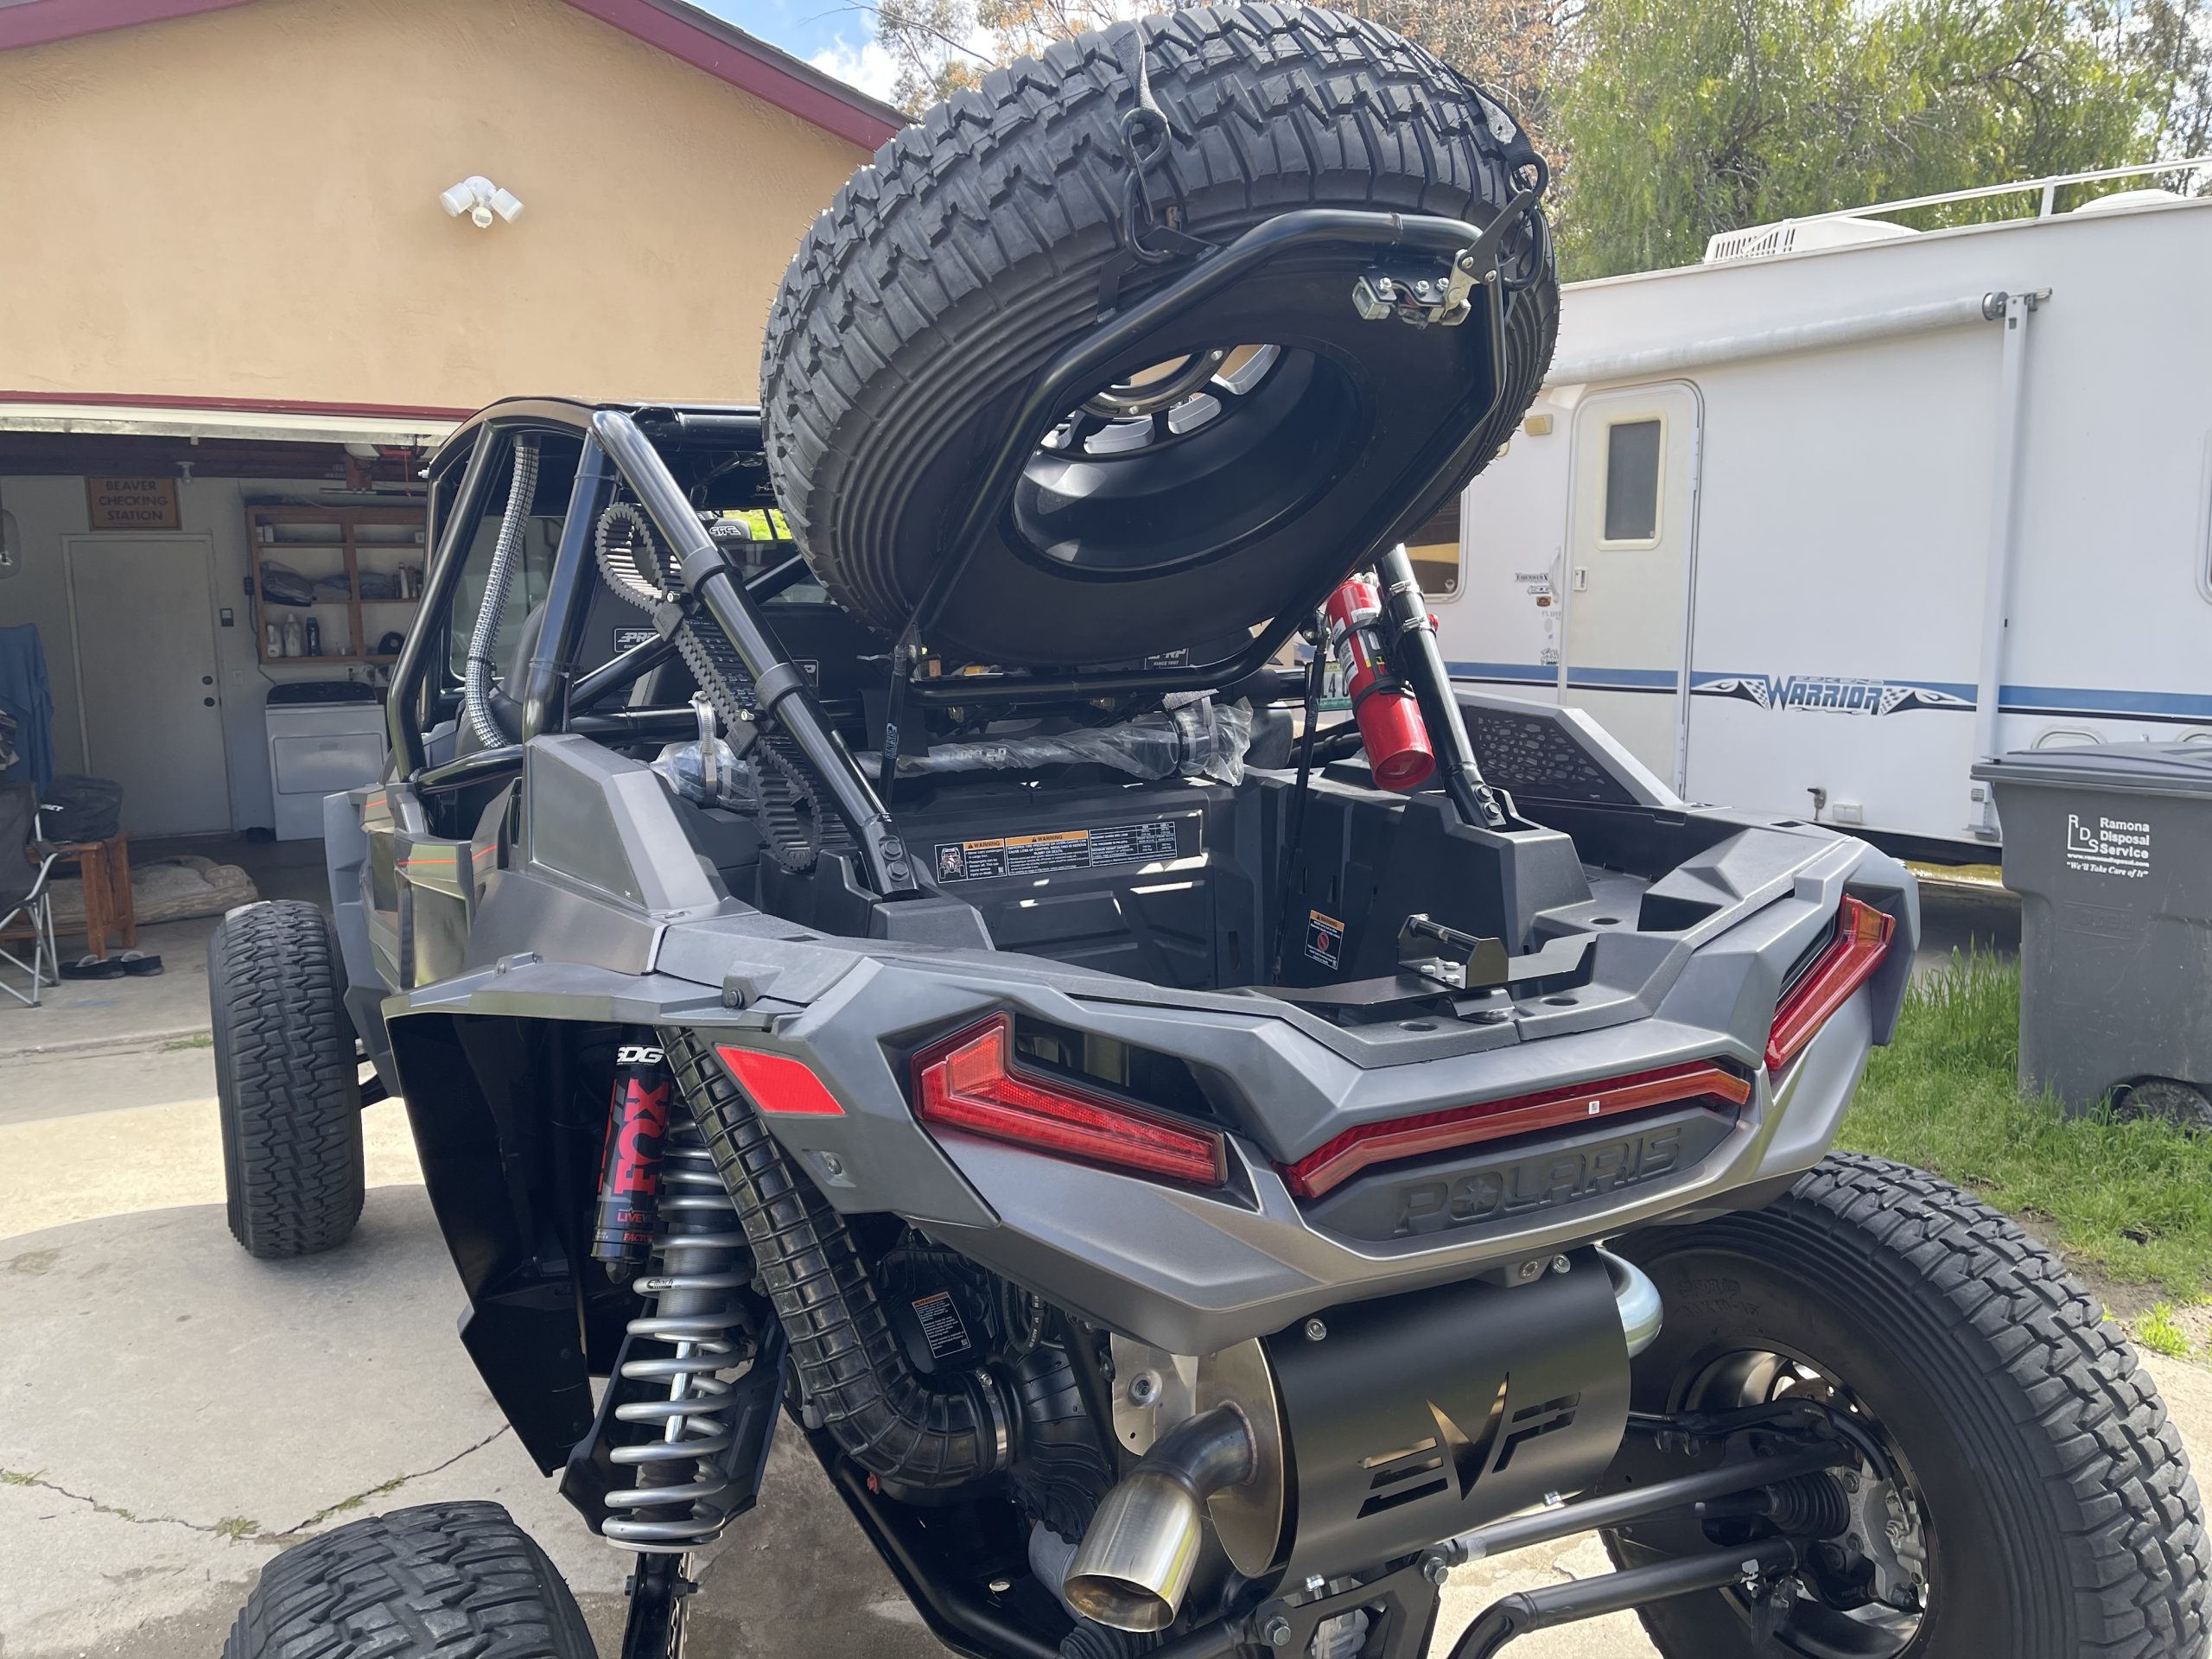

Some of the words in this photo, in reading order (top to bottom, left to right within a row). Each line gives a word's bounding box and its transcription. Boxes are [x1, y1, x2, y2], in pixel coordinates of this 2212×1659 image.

[105, 480, 156, 491] BEAVER
[99, 496, 168, 505] CHECKING
[107, 511, 162, 520] STATION
[1769, 676, 1883, 715] WARRIOR
[2100, 817, 2150, 832] Ramona
[973, 840, 1001, 849] WARNING
[2100, 830, 2150, 846] Disposal
[2100, 843, 2149, 859] Service
[2090, 864, 2107, 874] Take
[2108, 866, 2126, 875] Care
[2127, 868, 2137, 878] of
[614, 1078, 669, 1196] FOX
[1393, 1126, 1682, 1240] POLARIS
